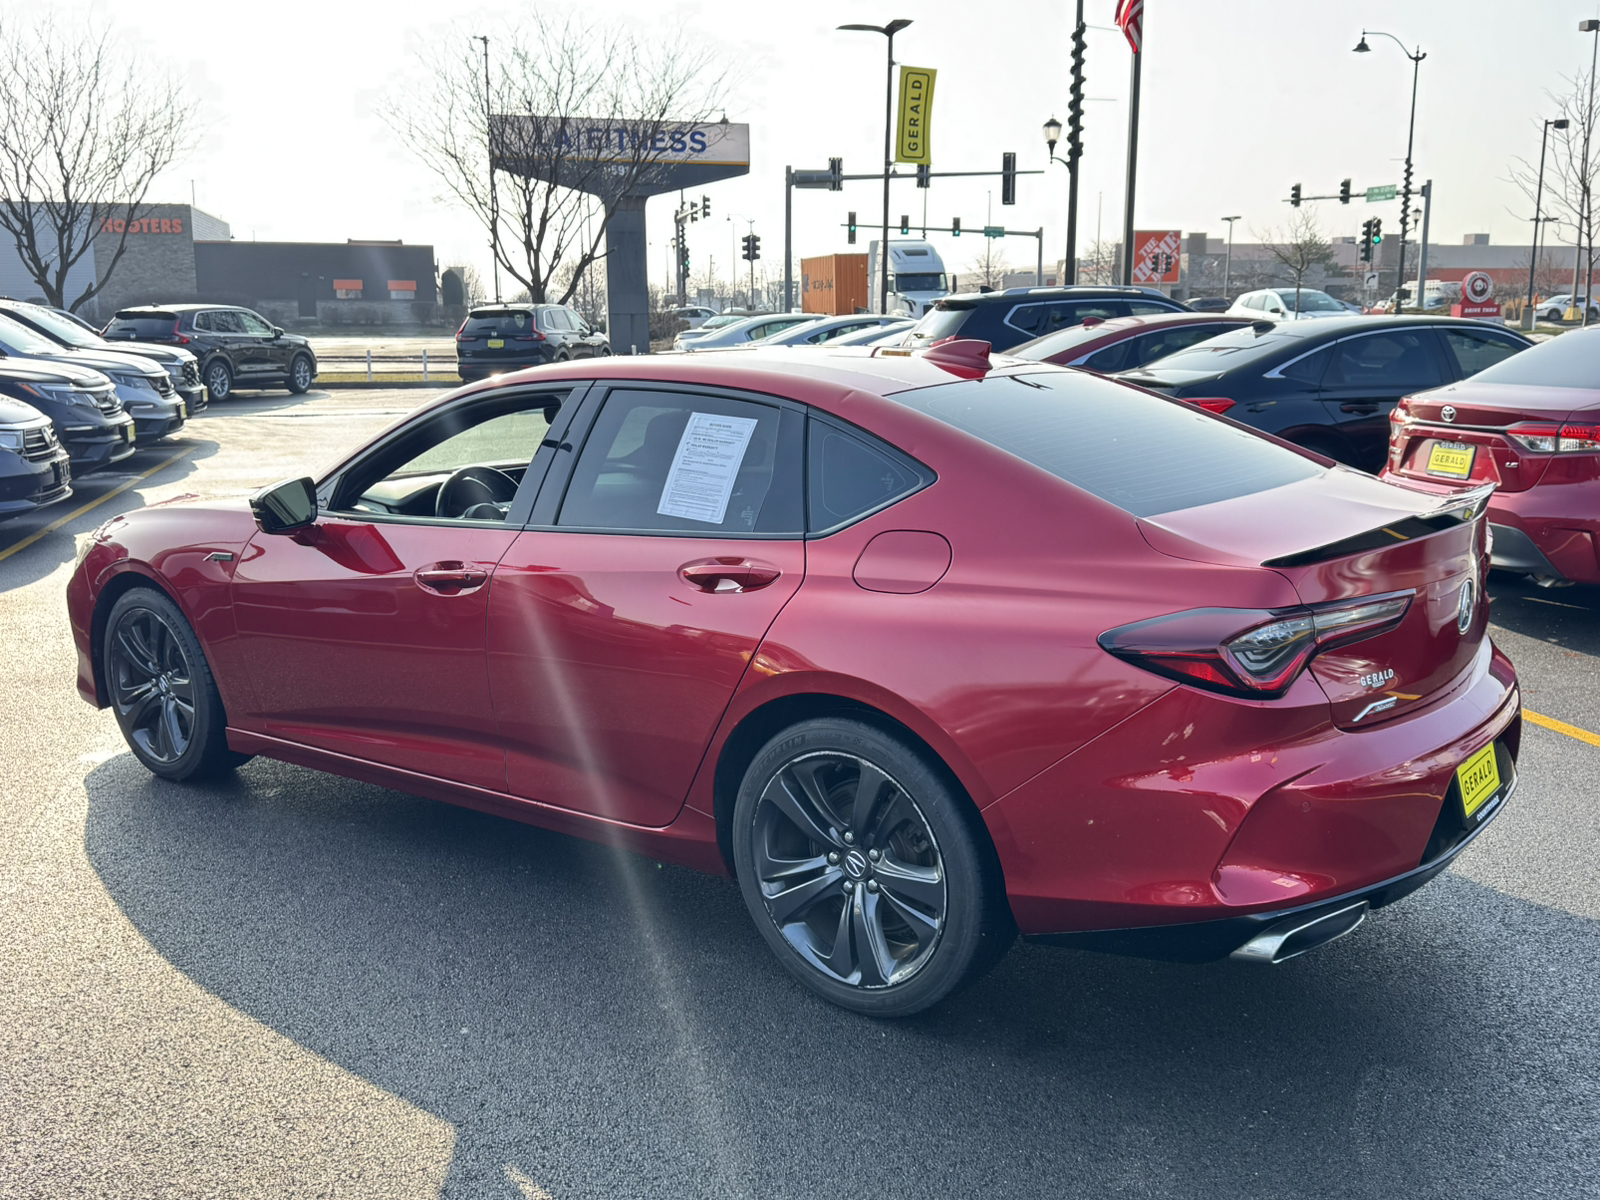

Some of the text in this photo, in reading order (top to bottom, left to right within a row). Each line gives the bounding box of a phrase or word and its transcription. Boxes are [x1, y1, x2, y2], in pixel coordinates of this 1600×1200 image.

[907, 79, 923, 152] GERALD
[586, 127, 708, 153] FITNESS
[100, 217, 183, 234] HOOTERS
[1133, 231, 1181, 282] HOME
[1138, 236, 1159, 257] THE
[1440, 441, 1466, 450] GERALD
[1434, 454, 1465, 466] GERALD
[1360, 668, 1394, 687] GERALD
[1464, 760, 1492, 795] GERALD
